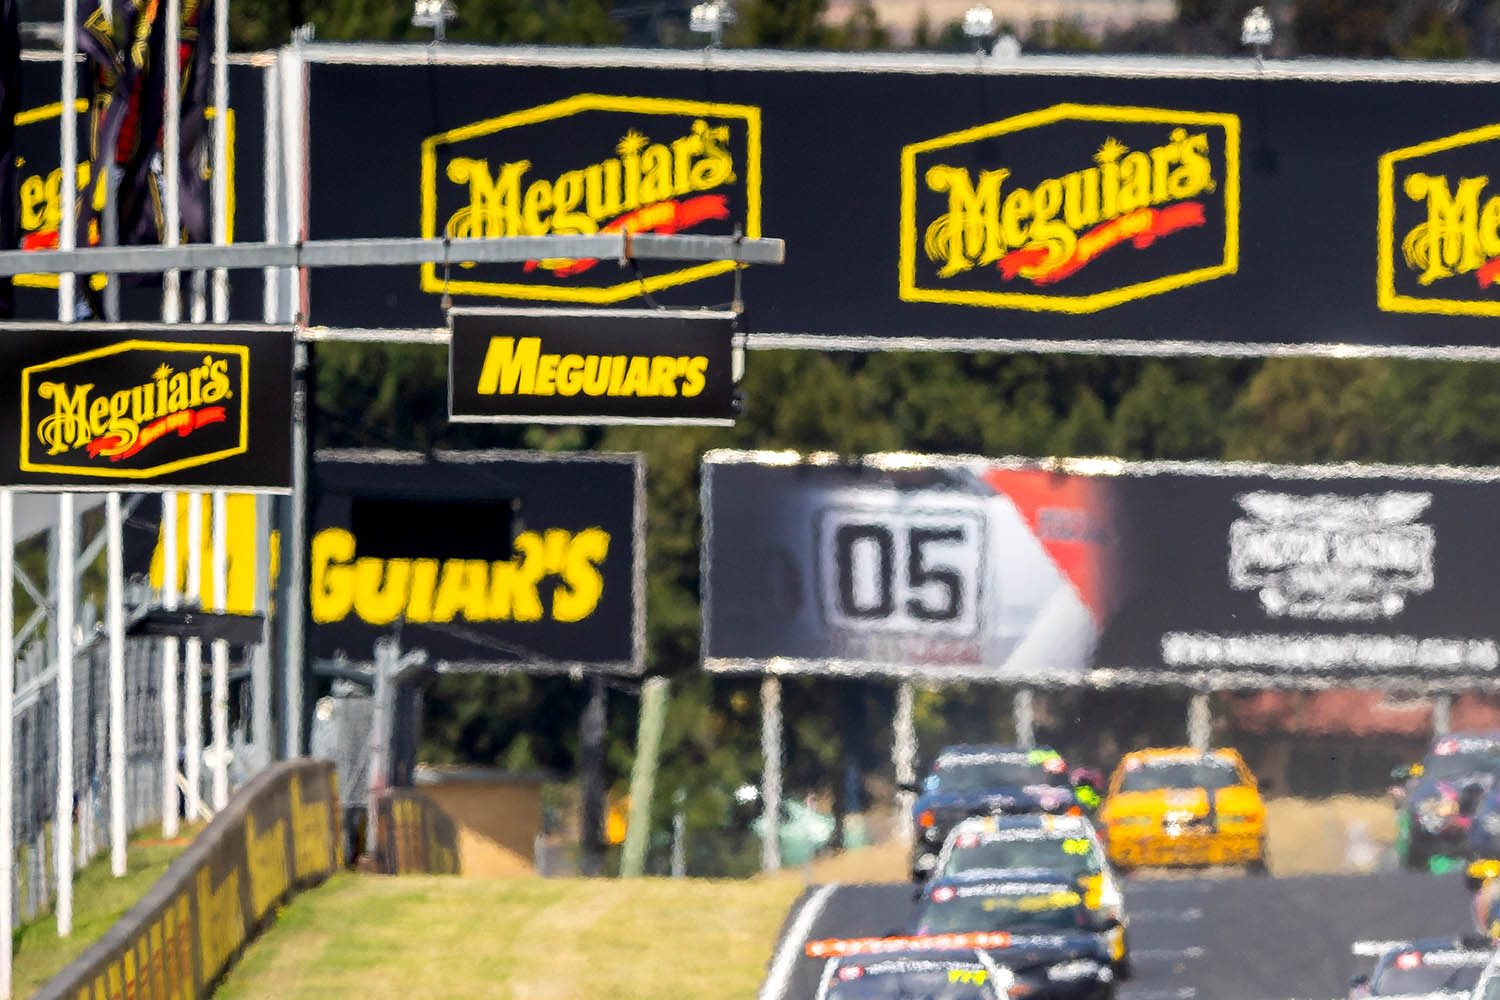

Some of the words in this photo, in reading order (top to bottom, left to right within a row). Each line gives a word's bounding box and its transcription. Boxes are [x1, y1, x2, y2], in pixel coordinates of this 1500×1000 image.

[447, 119, 737, 268] Meguiar's
[925, 128, 1216, 280] Meguiar's
[37, 355, 233, 456] Meguiar's
[835, 524, 963, 619] 05
